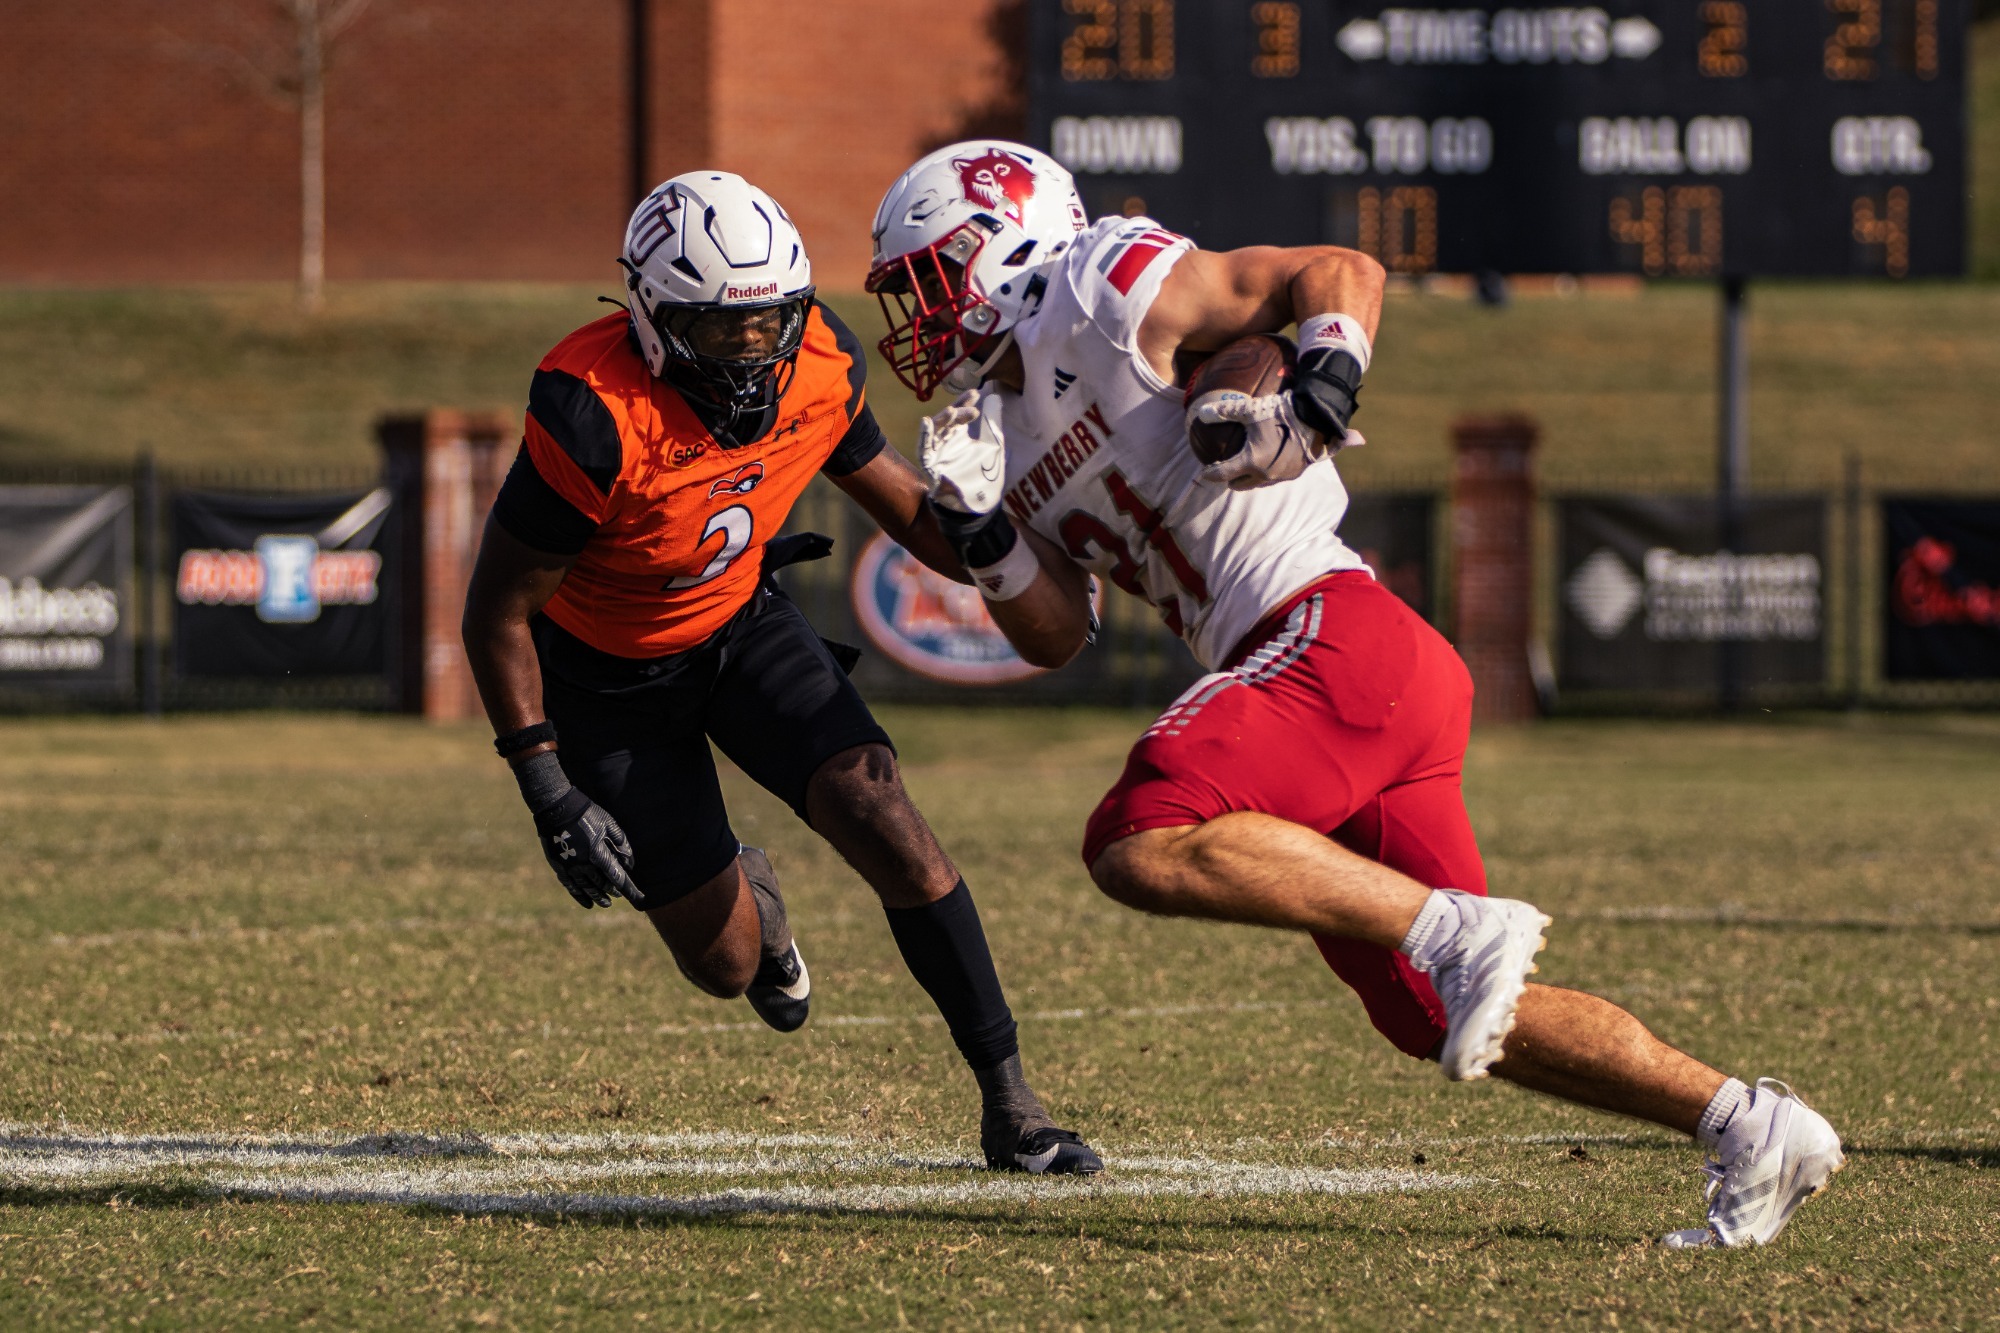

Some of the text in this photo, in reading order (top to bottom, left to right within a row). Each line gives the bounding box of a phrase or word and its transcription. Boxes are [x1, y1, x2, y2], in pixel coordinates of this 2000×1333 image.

[1061, 0, 1175, 81] 20
[1251, 2, 1299, 78] 3
[1379, 6, 1611, 65] TIME OUTS
[1698, 1, 1748, 77] 2
[1051, 115, 1183, 174] DOWN
[1364, 116, 1428, 175] TO
[1430, 116, 1493, 175] GO
[1578, 114, 1752, 175] BALL ON
[1830, 115, 1933, 176] QTR.
[1357, 186, 1438, 272] 10
[1609, 185, 1723, 277] 40
[1852, 185, 1909, 278] 4
[727, 282, 778, 299] Riddell
[673, 442, 706, 465] SAC
[1003, 401, 1115, 524] NEWBERRY
[660, 503, 754, 592] 2
